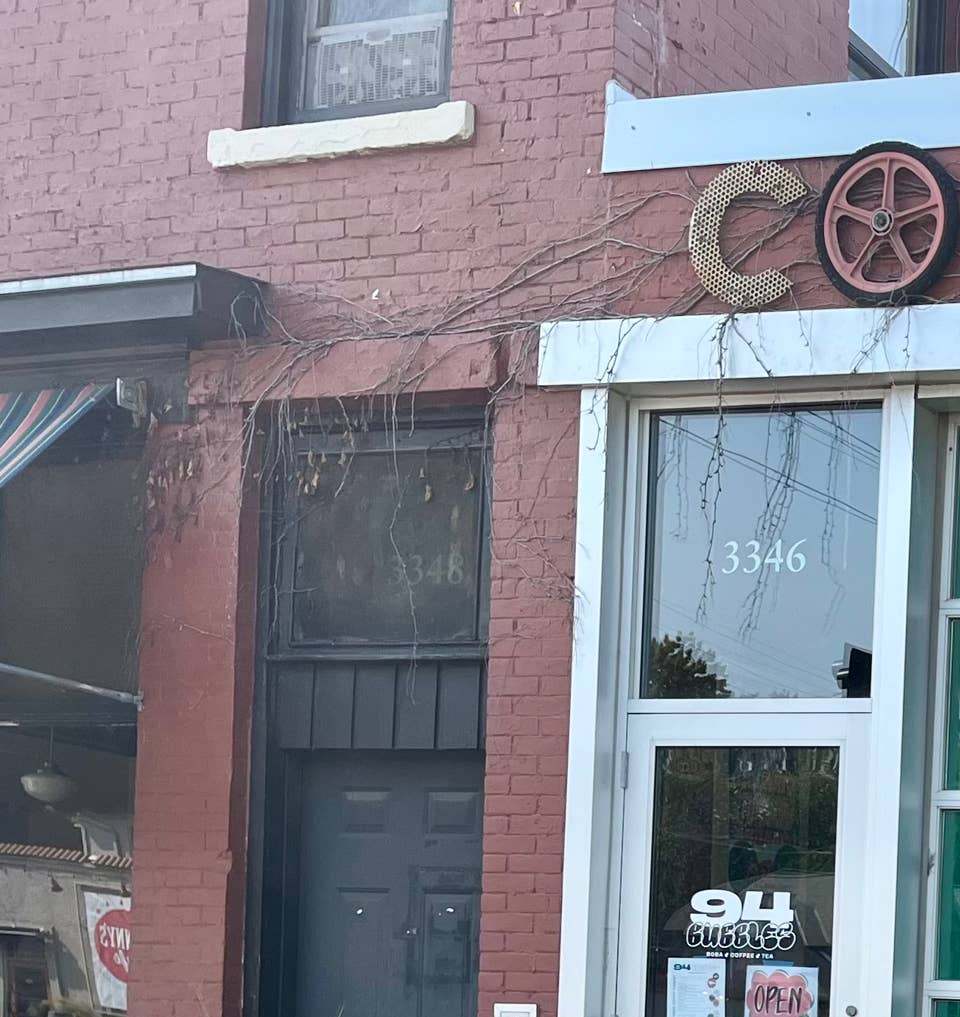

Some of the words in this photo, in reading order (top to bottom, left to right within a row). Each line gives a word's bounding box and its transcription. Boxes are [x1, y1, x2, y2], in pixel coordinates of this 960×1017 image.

[386, 553, 464, 585] 3348
[721, 538, 807, 574] 3346
[690, 888, 794, 925] 94
[686, 921, 797, 951] BUBBLES
[673, 963, 691, 971] 94
[754, 985, 803, 1014] OPEN
